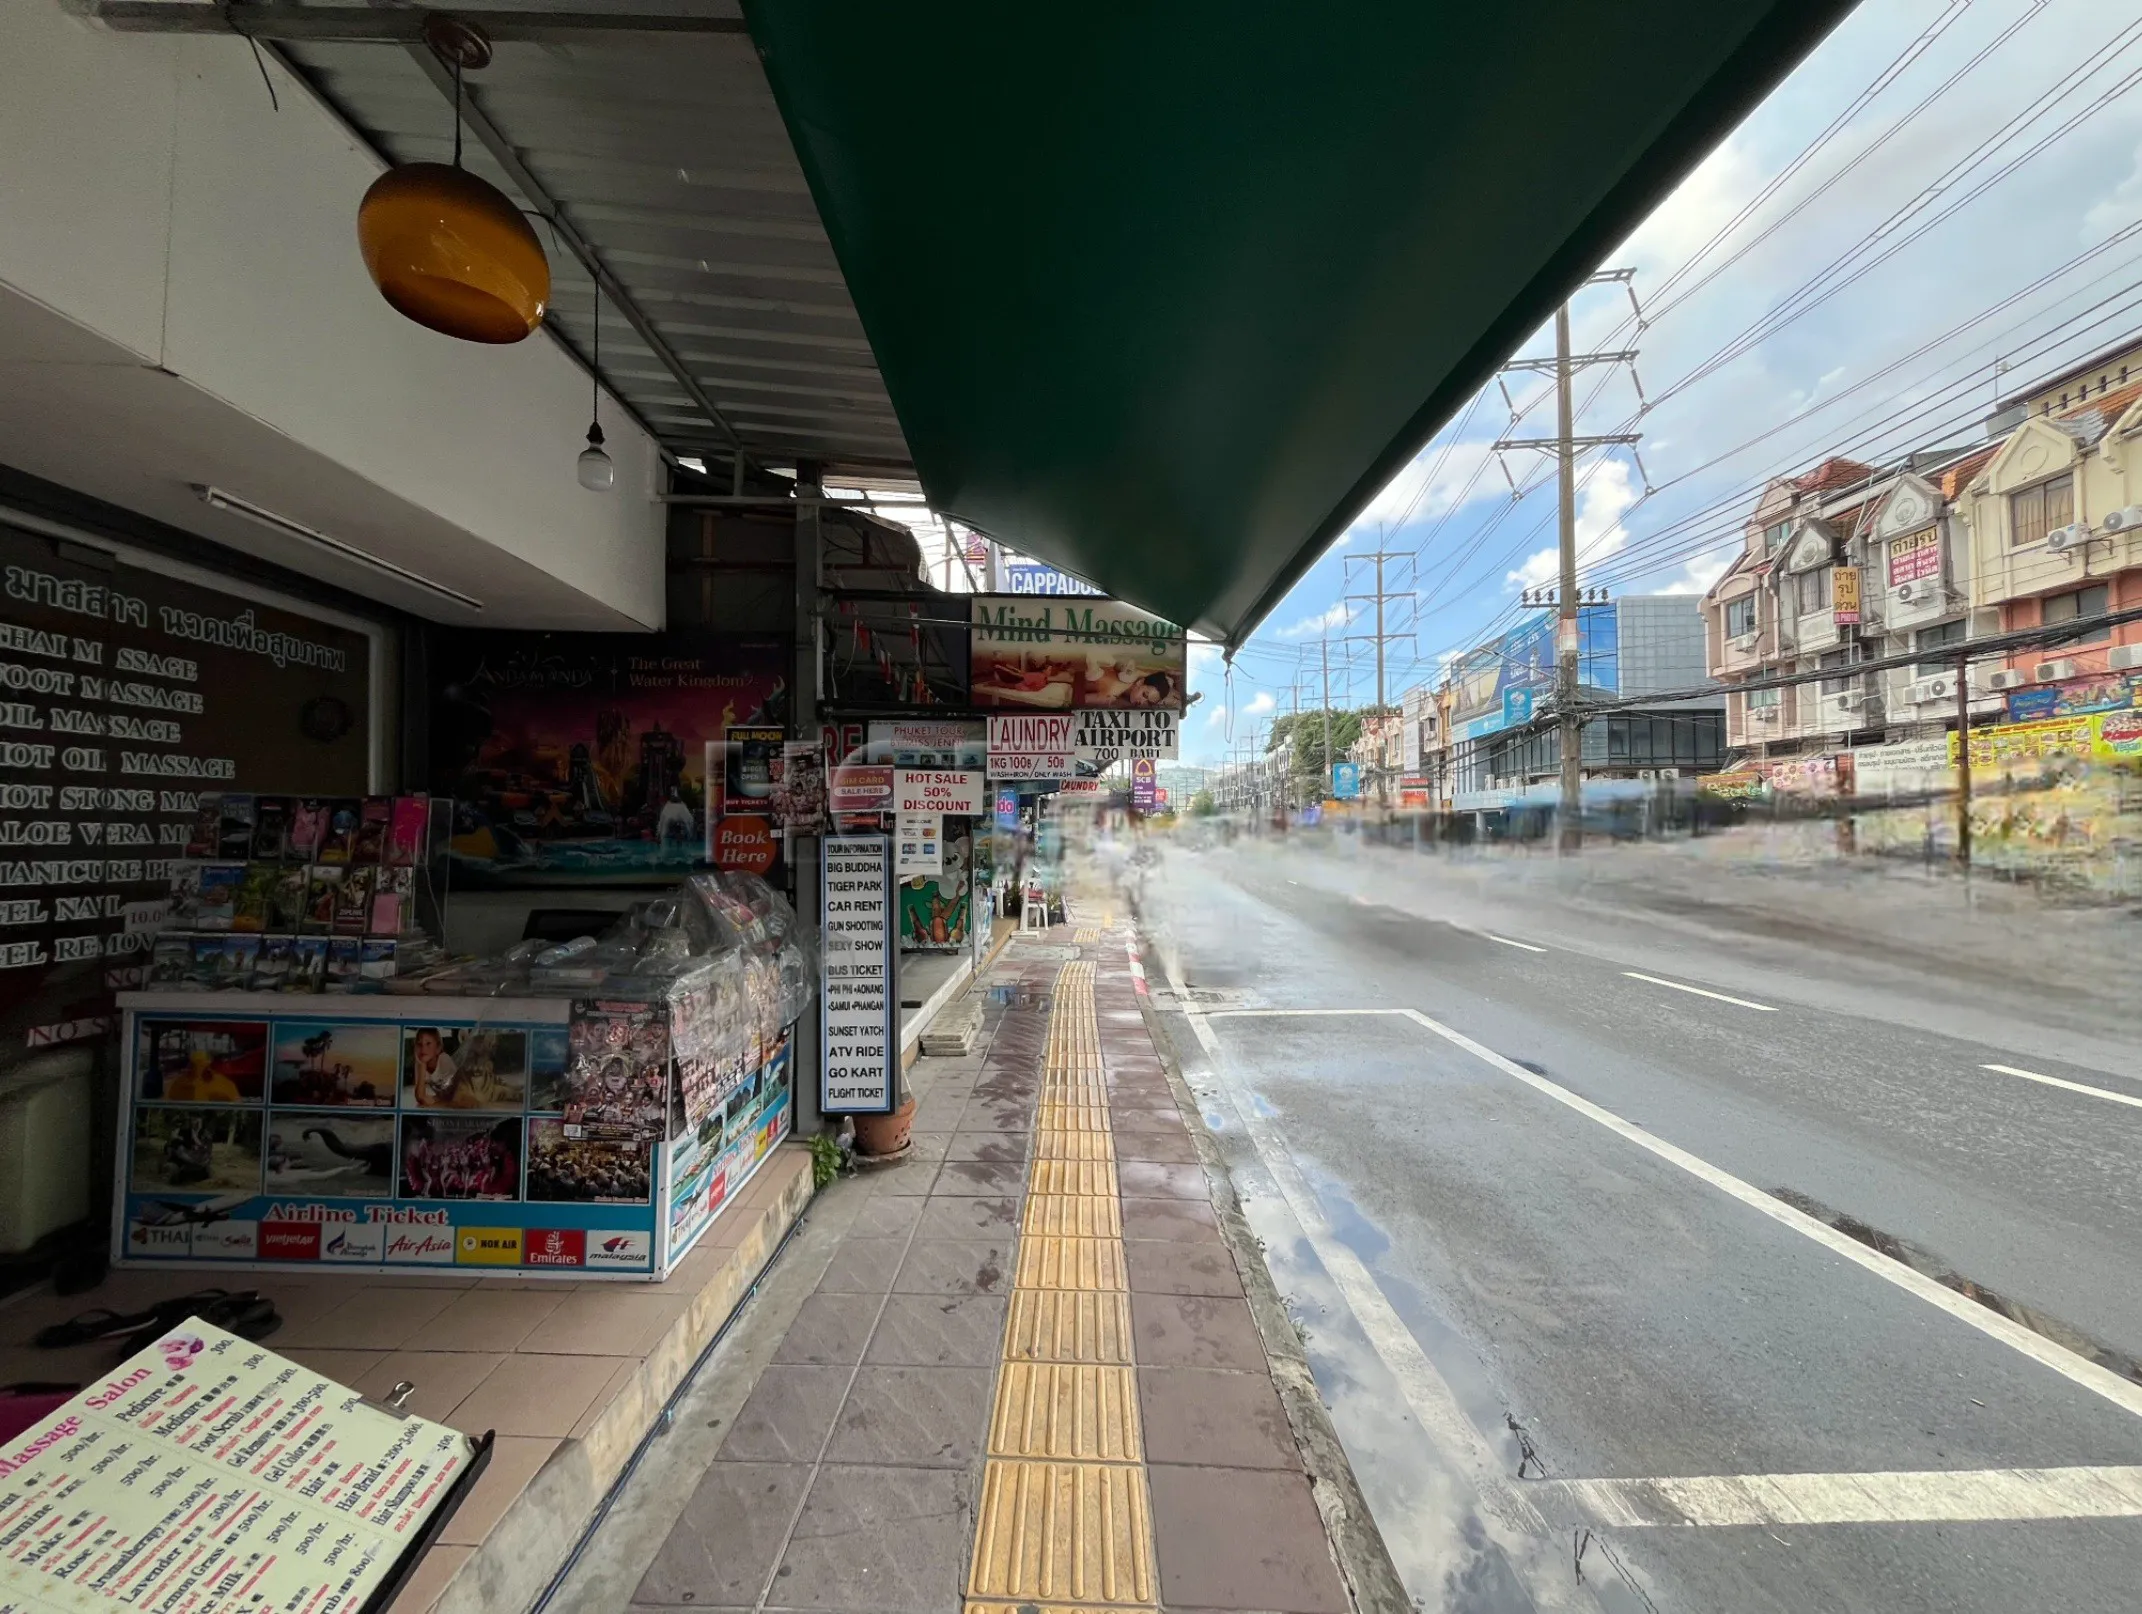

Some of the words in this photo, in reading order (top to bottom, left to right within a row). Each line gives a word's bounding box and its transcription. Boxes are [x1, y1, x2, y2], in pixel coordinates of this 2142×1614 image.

[978, 605, 1050, 642] Mind
[1065, 608, 1183, 655] Massage
[628, 656, 660, 671] The
[661, 656, 703, 671] Great
[628, 673, 676, 690] Water
[677, 673, 747, 691] Kingdom
[80, 674, 204, 715] MASSAGE
[50, 707, 181, 744] MASSAGE
[1081, 711, 1130, 729] TAXI
[1141, 711, 1171, 729] TO
[751, 731, 783, 741] MOON
[894, 726, 931, 736] PHUKET
[990, 718, 1071, 751] LAUNDRY
[1075, 729, 1176, 747] AIRPORT
[1094, 748, 1119, 760] 700
[1130, 749, 1162, 759] BAHT
[120, 750, 236, 780] MASSAGE
[990, 757, 1006, 769] 1KG
[860, 776, 884, 785] CARD
[905, 773, 931, 784] HOT
[934, 773, 968, 784] SALE
[863, 787, 884, 795] HERE
[923, 787, 952, 797] 50%
[904, 800, 971, 811] DISCOUNT
[77, 821, 155, 846] VERA
[721, 829, 768, 844] Book
[722, 848, 768, 863] Here
[827, 844, 842, 853] TOUR
[843, 844, 882, 853] INFORMATION
[827, 862, 843, 872] BIG
[845, 862, 882, 872] BUDDHA
[828, 881, 855, 891] TIGER
[857, 881, 882, 891] PARK
[54, 895, 125, 922] NAIL
[828, 901, 851, 911] CAR
[854, 901, 883, 911] RENT
[828, 921, 844, 931] GUN
[845, 921, 883, 931] SHOOTING
[828, 941, 852, 951] SEXY
[855, 941, 883, 951] SHOW
[828, 965, 848, 975] BUS
[850, 965, 883, 975] TICKET
[828, 1026, 857, 1036] SUNSET
[859, 1026, 884, 1036] YATCH
[829, 1046, 852, 1057] ATV
[856, 1046, 884, 1057] RIDE
[828, 1068, 848, 1078] GO
[851, 1068, 884, 1078] KART
[828, 1088, 856, 1098] FLIGHT
[857, 1088, 884, 1098] TICKET
[264, 1203, 356, 1223] Airline
[364, 1204, 449, 1225] Ticket
[480, 1239, 499, 1249] NOK
[502, 1239, 517, 1249] AIR
[530, 1253, 578, 1265] Emirates
[589, 1253, 646, 1262] malaysia
[84, 1368, 153, 1411] Salon
[115, 1387, 167, 1422] Pedicure
[152, 1401, 204, 1438] Medicure
[189, 1427, 221, 1453] Foot
[218, 1410, 244, 1436] Scrub
[226, 1451, 249, 1468] Gel
[263, 1466, 287, 1484] Gel
[279, 1445, 306, 1469] Color
[298, 1475, 325, 1499] Hair
[334, 1489, 362, 1513] Hair
[353, 1468, 380, 1493] Braid
[370, 1506, 395, 1526] Hair
[387, 1476, 417, 1508] Shampoo
[19, 1532, 67, 1566] Moke
[53, 1547, 94, 1579] Rose
[88, 1526, 165, 1592] Aromatherapy
[118, 1547, 183, 1604] Lavender
[151, 1579, 197, 1614] Lemon
[191, 1548, 226, 1578] Grass
[211, 1572, 244, 1601] Milk
